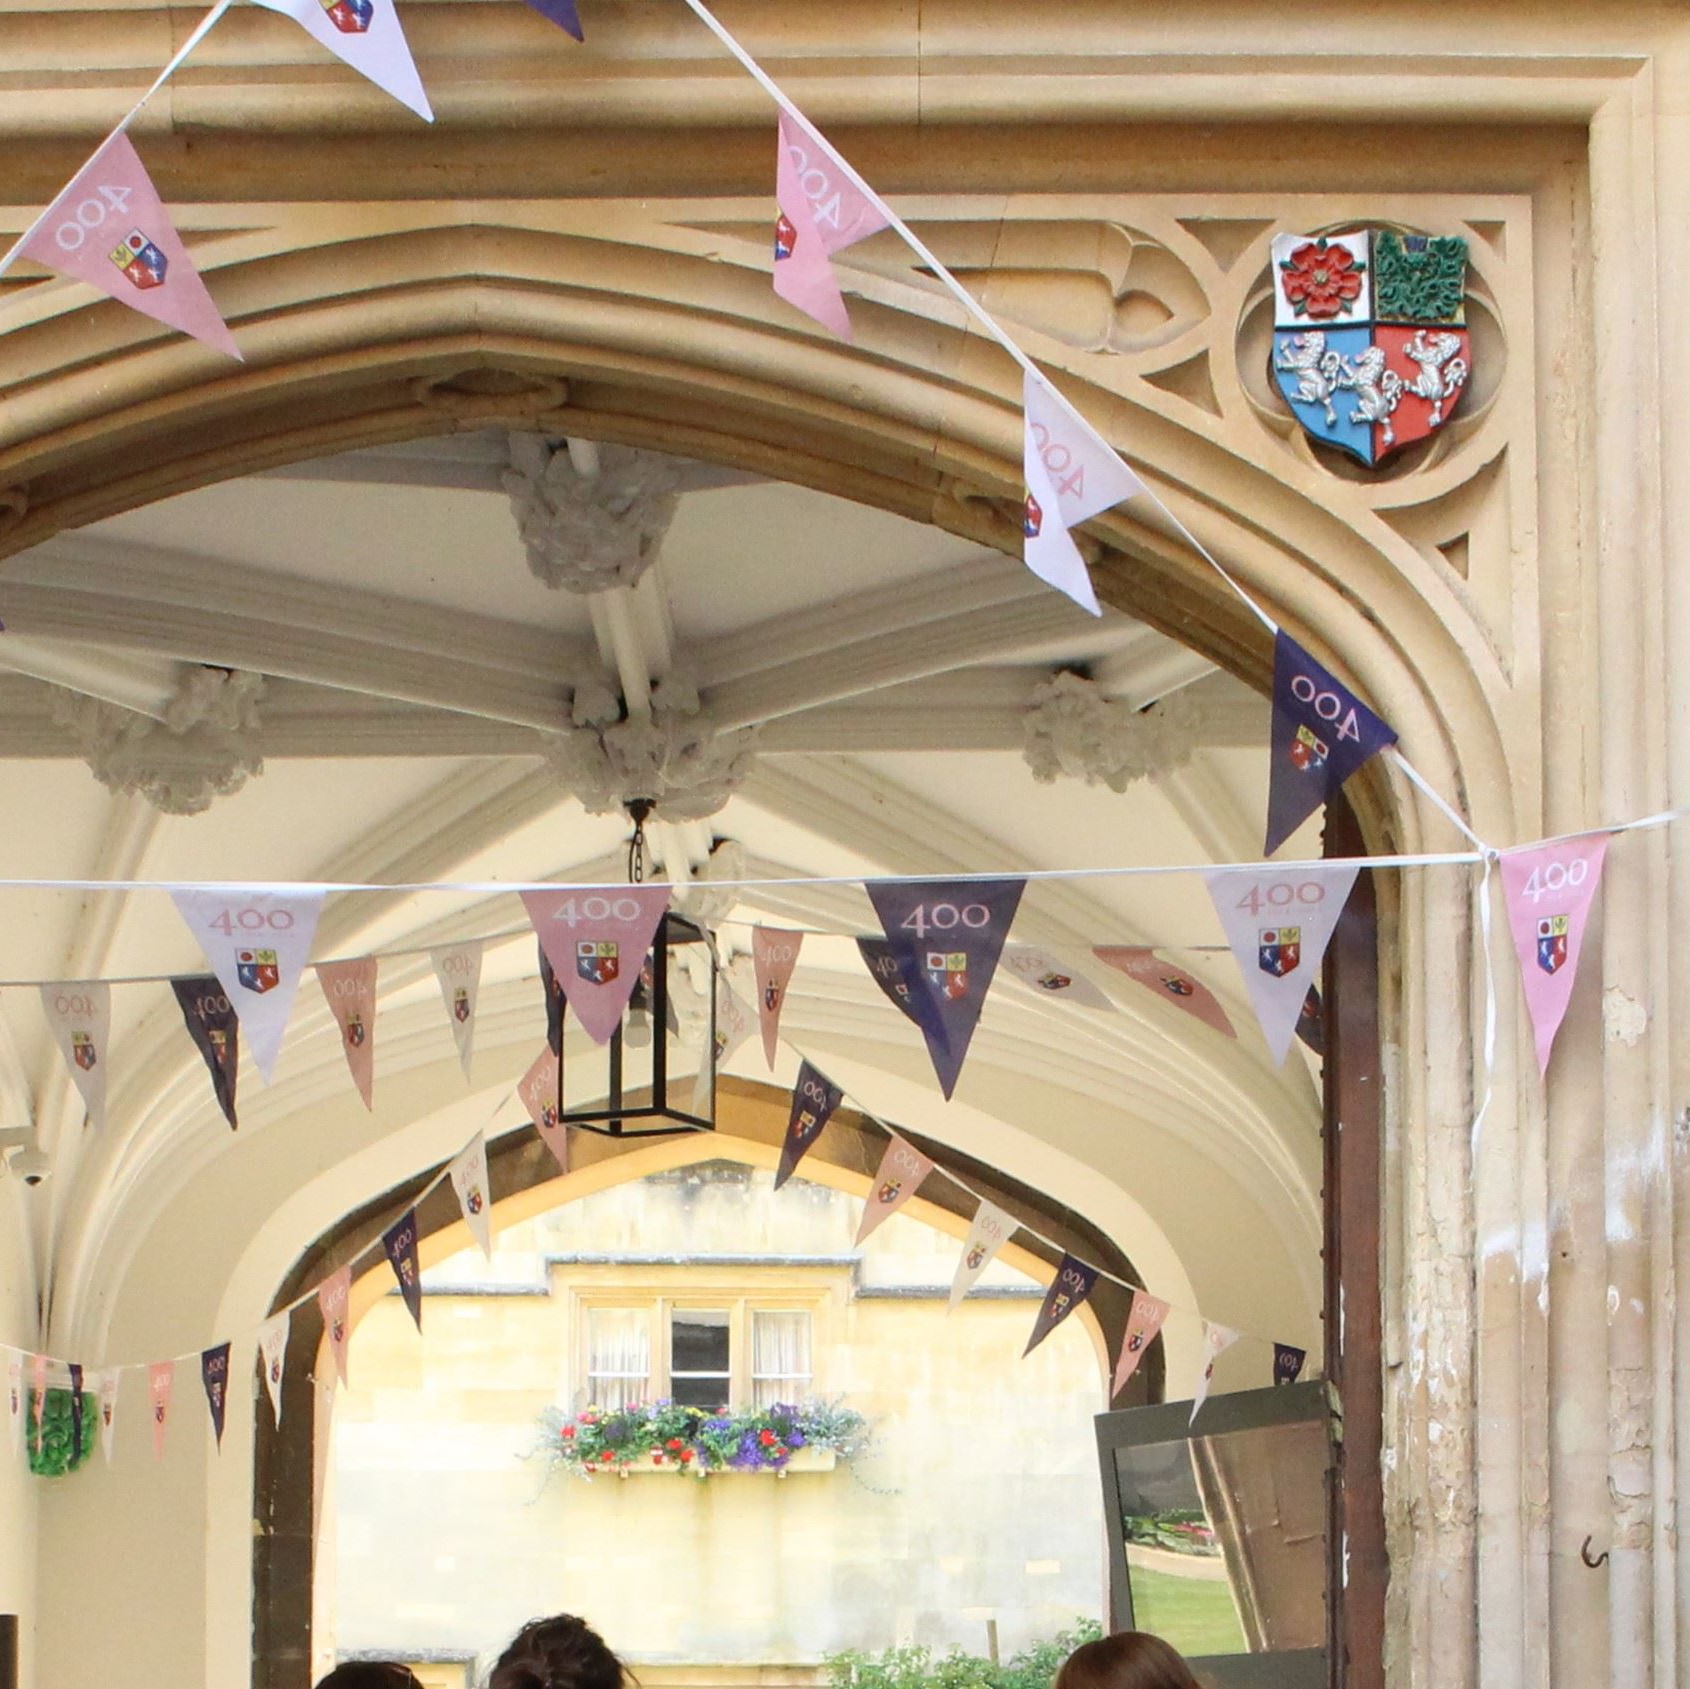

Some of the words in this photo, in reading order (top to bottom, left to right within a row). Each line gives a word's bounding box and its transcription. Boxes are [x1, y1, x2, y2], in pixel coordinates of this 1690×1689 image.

[1523, 857, 1588, 903] 400
[553, 897, 641, 928] 400
[1236, 882, 1325, 916] 400
[209, 908, 295, 936] 400
[901, 904, 990, 938] 400
[877, 957, 898, 979] 40
